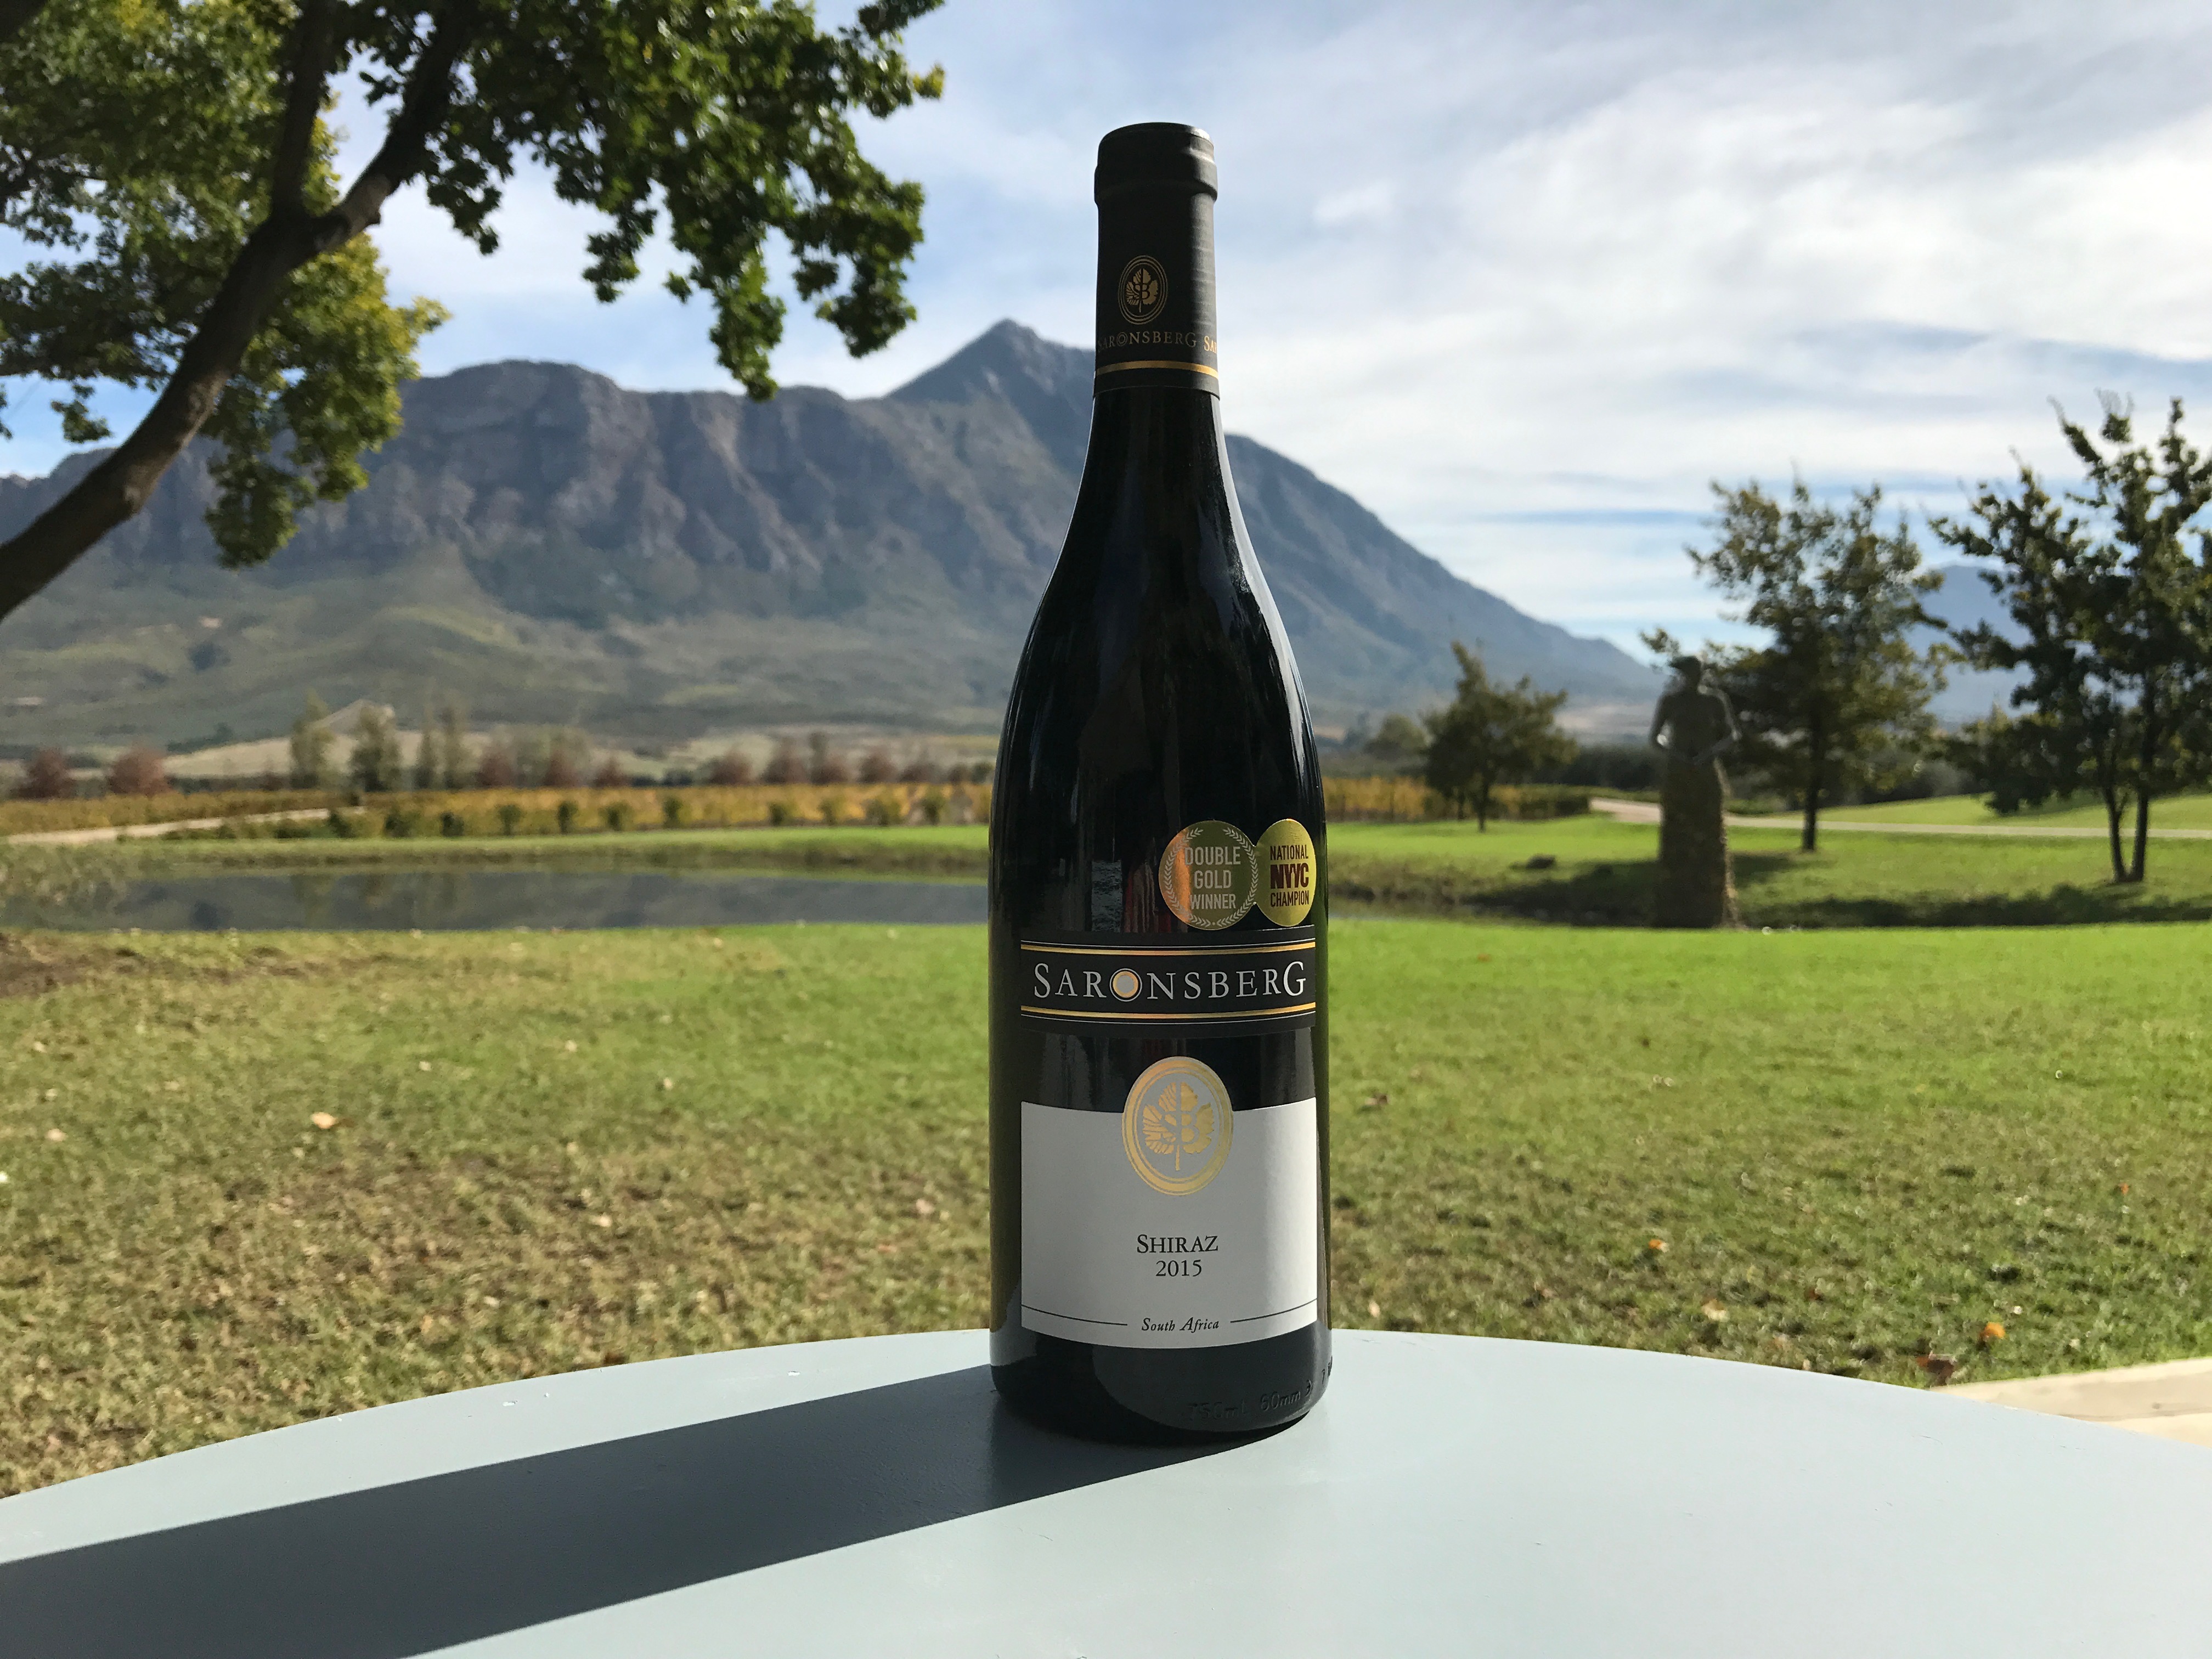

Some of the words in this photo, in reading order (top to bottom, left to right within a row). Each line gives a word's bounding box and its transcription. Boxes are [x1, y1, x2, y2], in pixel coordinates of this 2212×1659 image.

[1185, 847, 1241, 865] DOUBLE
[1270, 844, 1309, 860] NATIONAL
[1194, 870, 1232, 889] GOLD
[1189, 893, 1237, 910] WINNER
[1270, 890, 1309, 907] CHAMPION
[1034, 961, 1306, 1002] SARONSBERG
[1137, 1234, 1218, 1254] SHIRAZ
[1155, 1259, 1202, 1277] 2015
[1141, 1317, 1176, 1331] South
[1180, 1317, 1219, 1333] Africa
